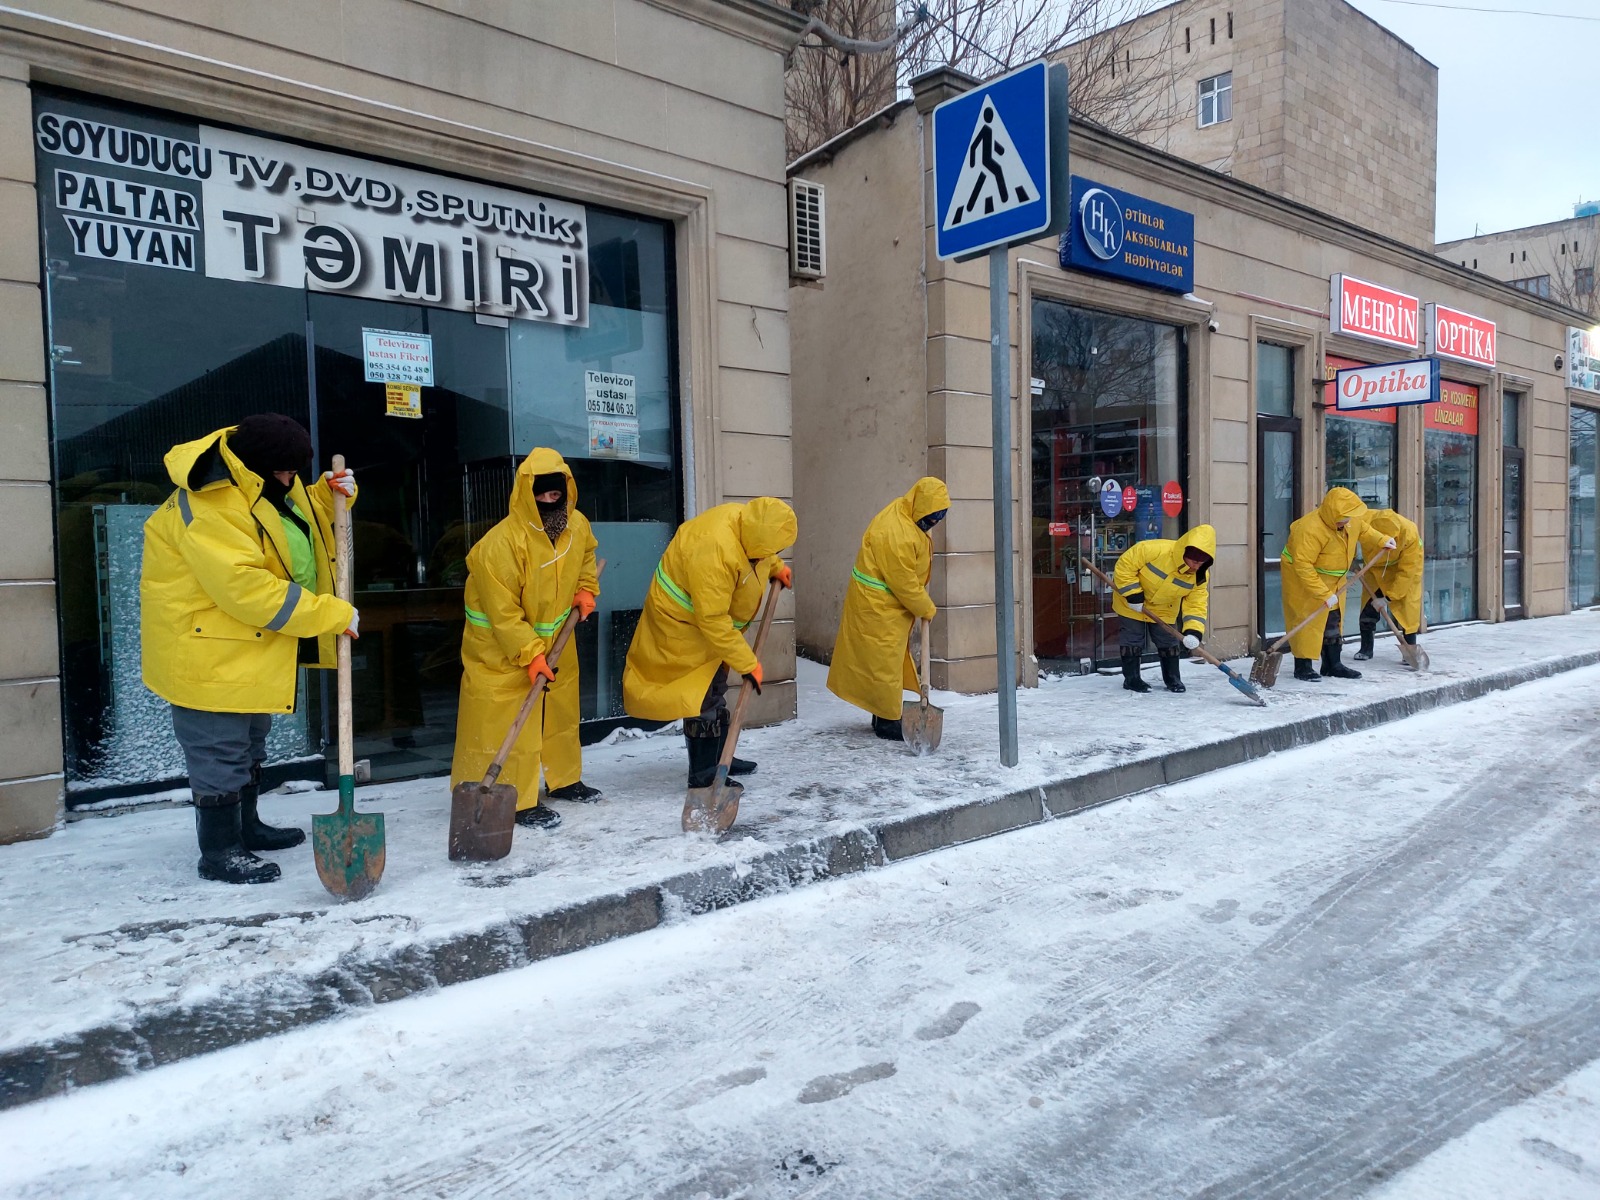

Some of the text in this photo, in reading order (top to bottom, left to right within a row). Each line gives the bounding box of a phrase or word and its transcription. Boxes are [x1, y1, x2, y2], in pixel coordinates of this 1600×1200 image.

[39, 113, 213, 180] SOYUDUCU
[218, 149, 278, 181] TV
[57, 171, 197, 227] PALTAR
[68, 216, 194, 268] YUYAN
[1124, 229, 1188, 258] AKSESUARLAR
[222, 209, 578, 317] TƏMİRİ
[1343, 292, 1417, 343] MEHRİN
[376, 337, 420, 350] Televizor
[1437, 318, 1494, 362] OPTİKA
[369, 362, 384, 370] 055
[386, 363, 400, 371] 354
[370, 371, 384, 379] 050
[386, 372, 401, 380] 328
[588, 371, 634, 387] Televizor
[596, 389, 627, 401] ustası
[1342, 369, 1428, 403] Optika
[588, 399, 634, 415] 055 784 06 32
[1434, 405, 1464, 427] LİNZALAR
